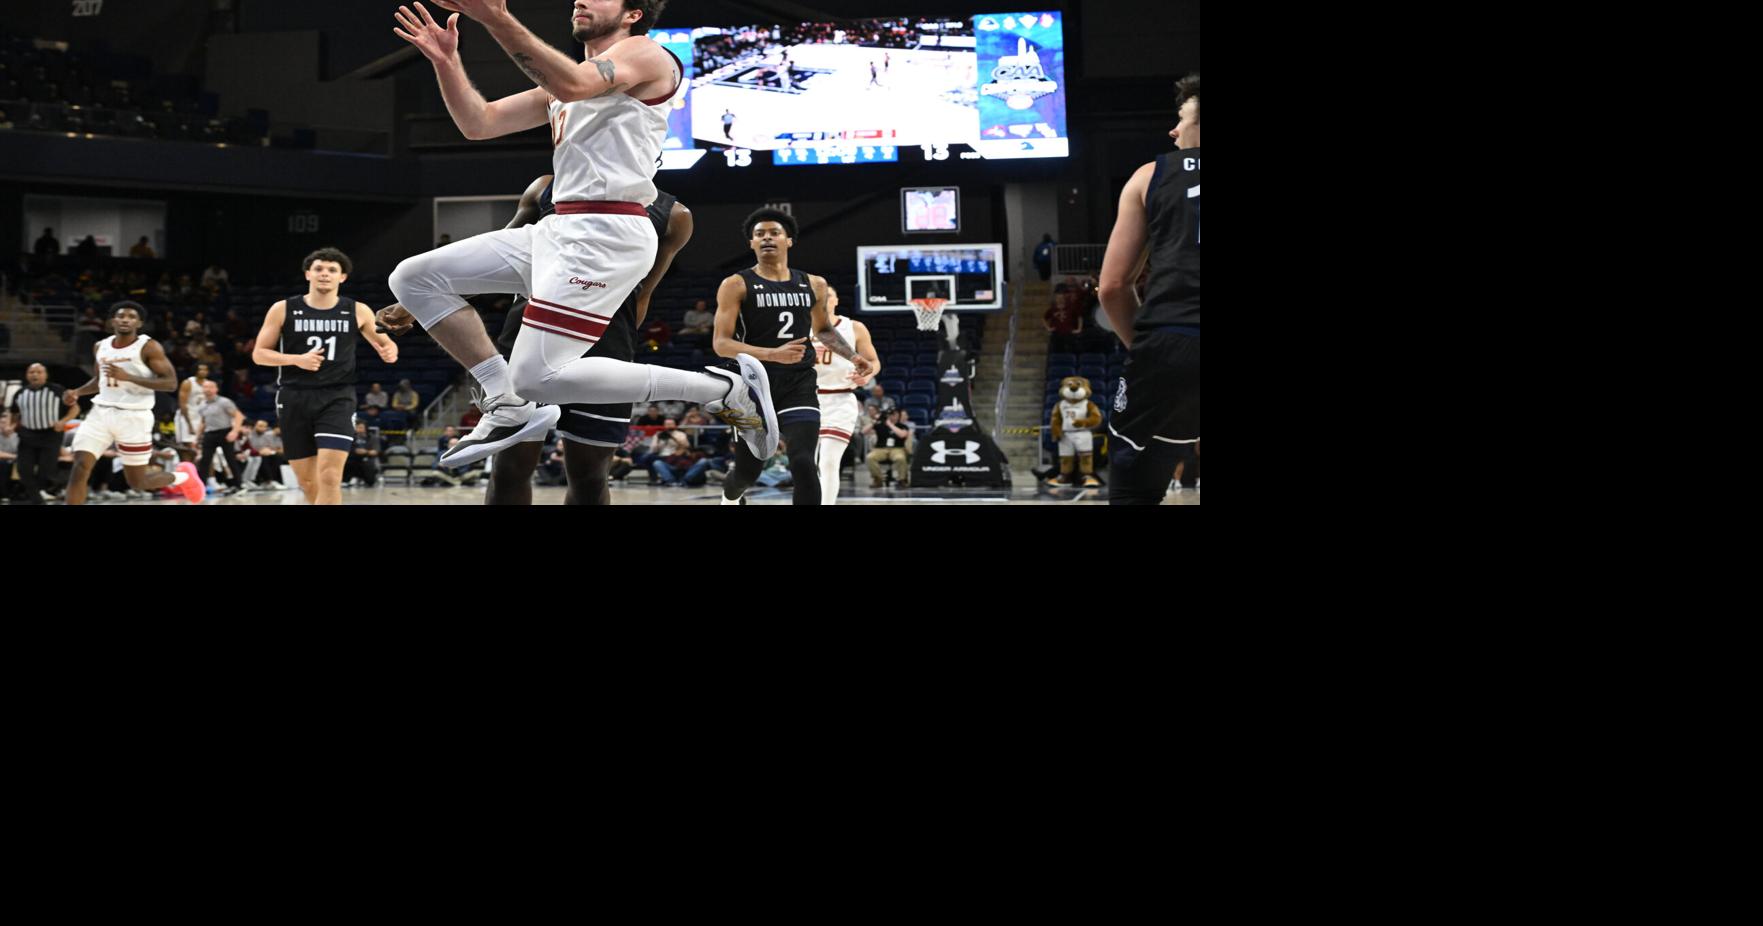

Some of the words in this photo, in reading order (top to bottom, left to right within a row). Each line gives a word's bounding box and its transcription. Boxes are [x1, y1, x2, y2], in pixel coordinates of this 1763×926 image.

[73, 0, 103, 16] 207
[724, 148, 752, 167] 13
[921, 142, 949, 160] 13
[1183, 157, 1200, 171] C
[288, 215, 319, 232] 109
[569, 276, 606, 290] Cougars
[756, 293, 811, 307] MONMOUTH
[294, 319, 349, 333] MONMOUTH
[777, 311, 794, 339] 2
[307, 335, 337, 361] 21
